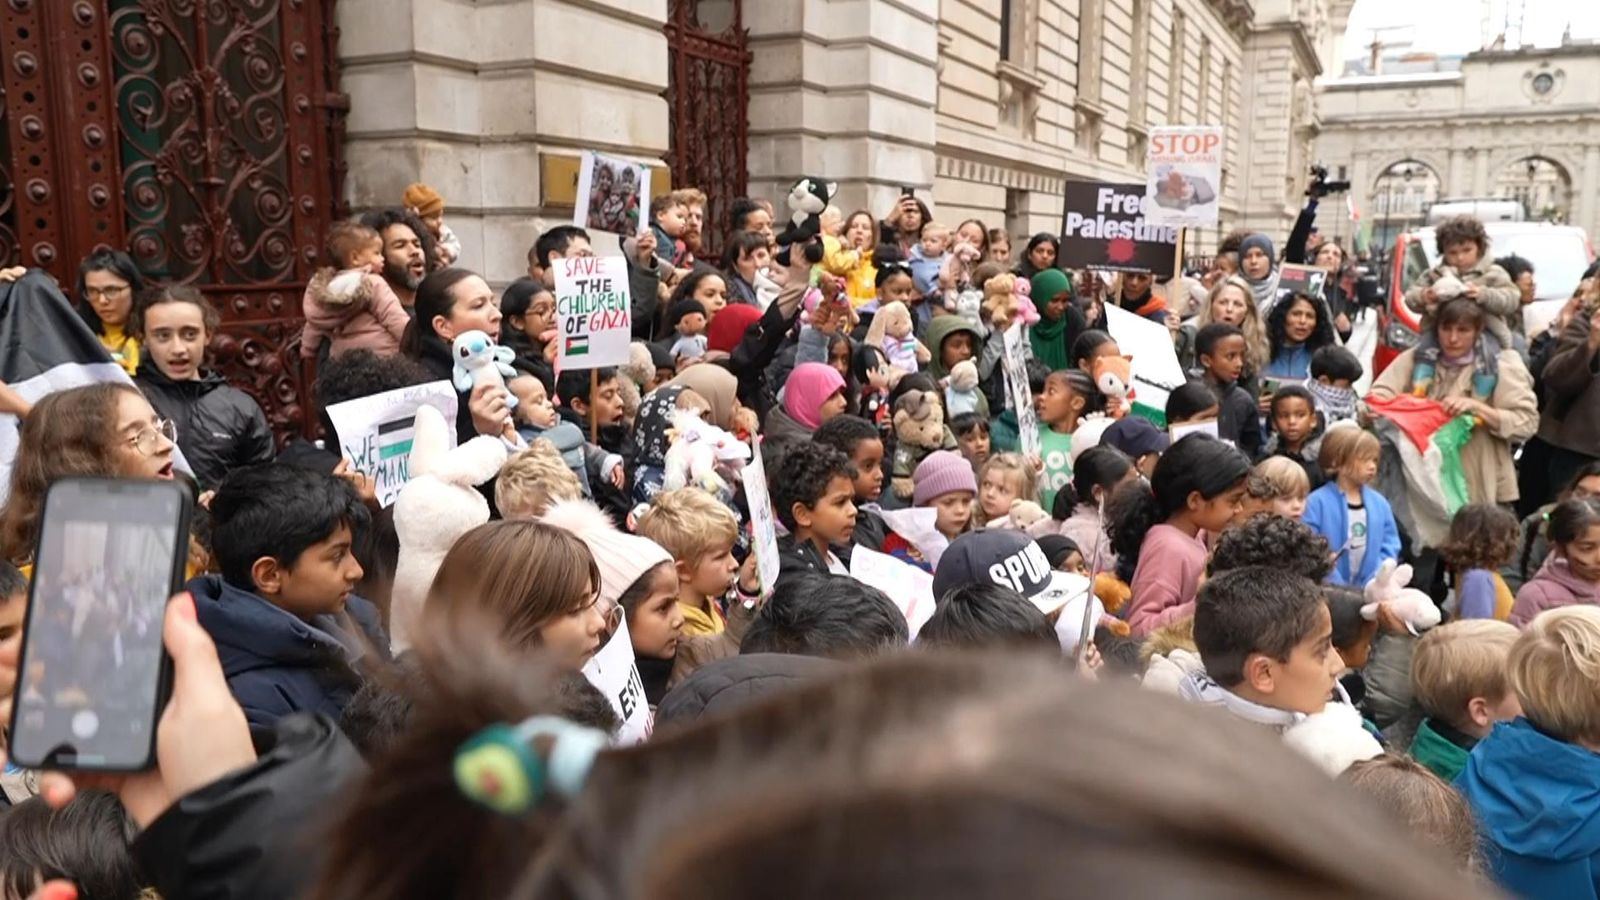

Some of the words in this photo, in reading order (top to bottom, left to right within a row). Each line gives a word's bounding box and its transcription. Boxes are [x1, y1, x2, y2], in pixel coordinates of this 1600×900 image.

[1151, 133, 1219, 154] STOP
[565, 257, 605, 277] SAVE
[576, 279, 612, 294] THE
[558, 291, 626, 316] CHILDREN
[566, 315, 587, 334] OF
[590, 310, 629, 331] GAZA
[345, 434, 375, 468] WE
